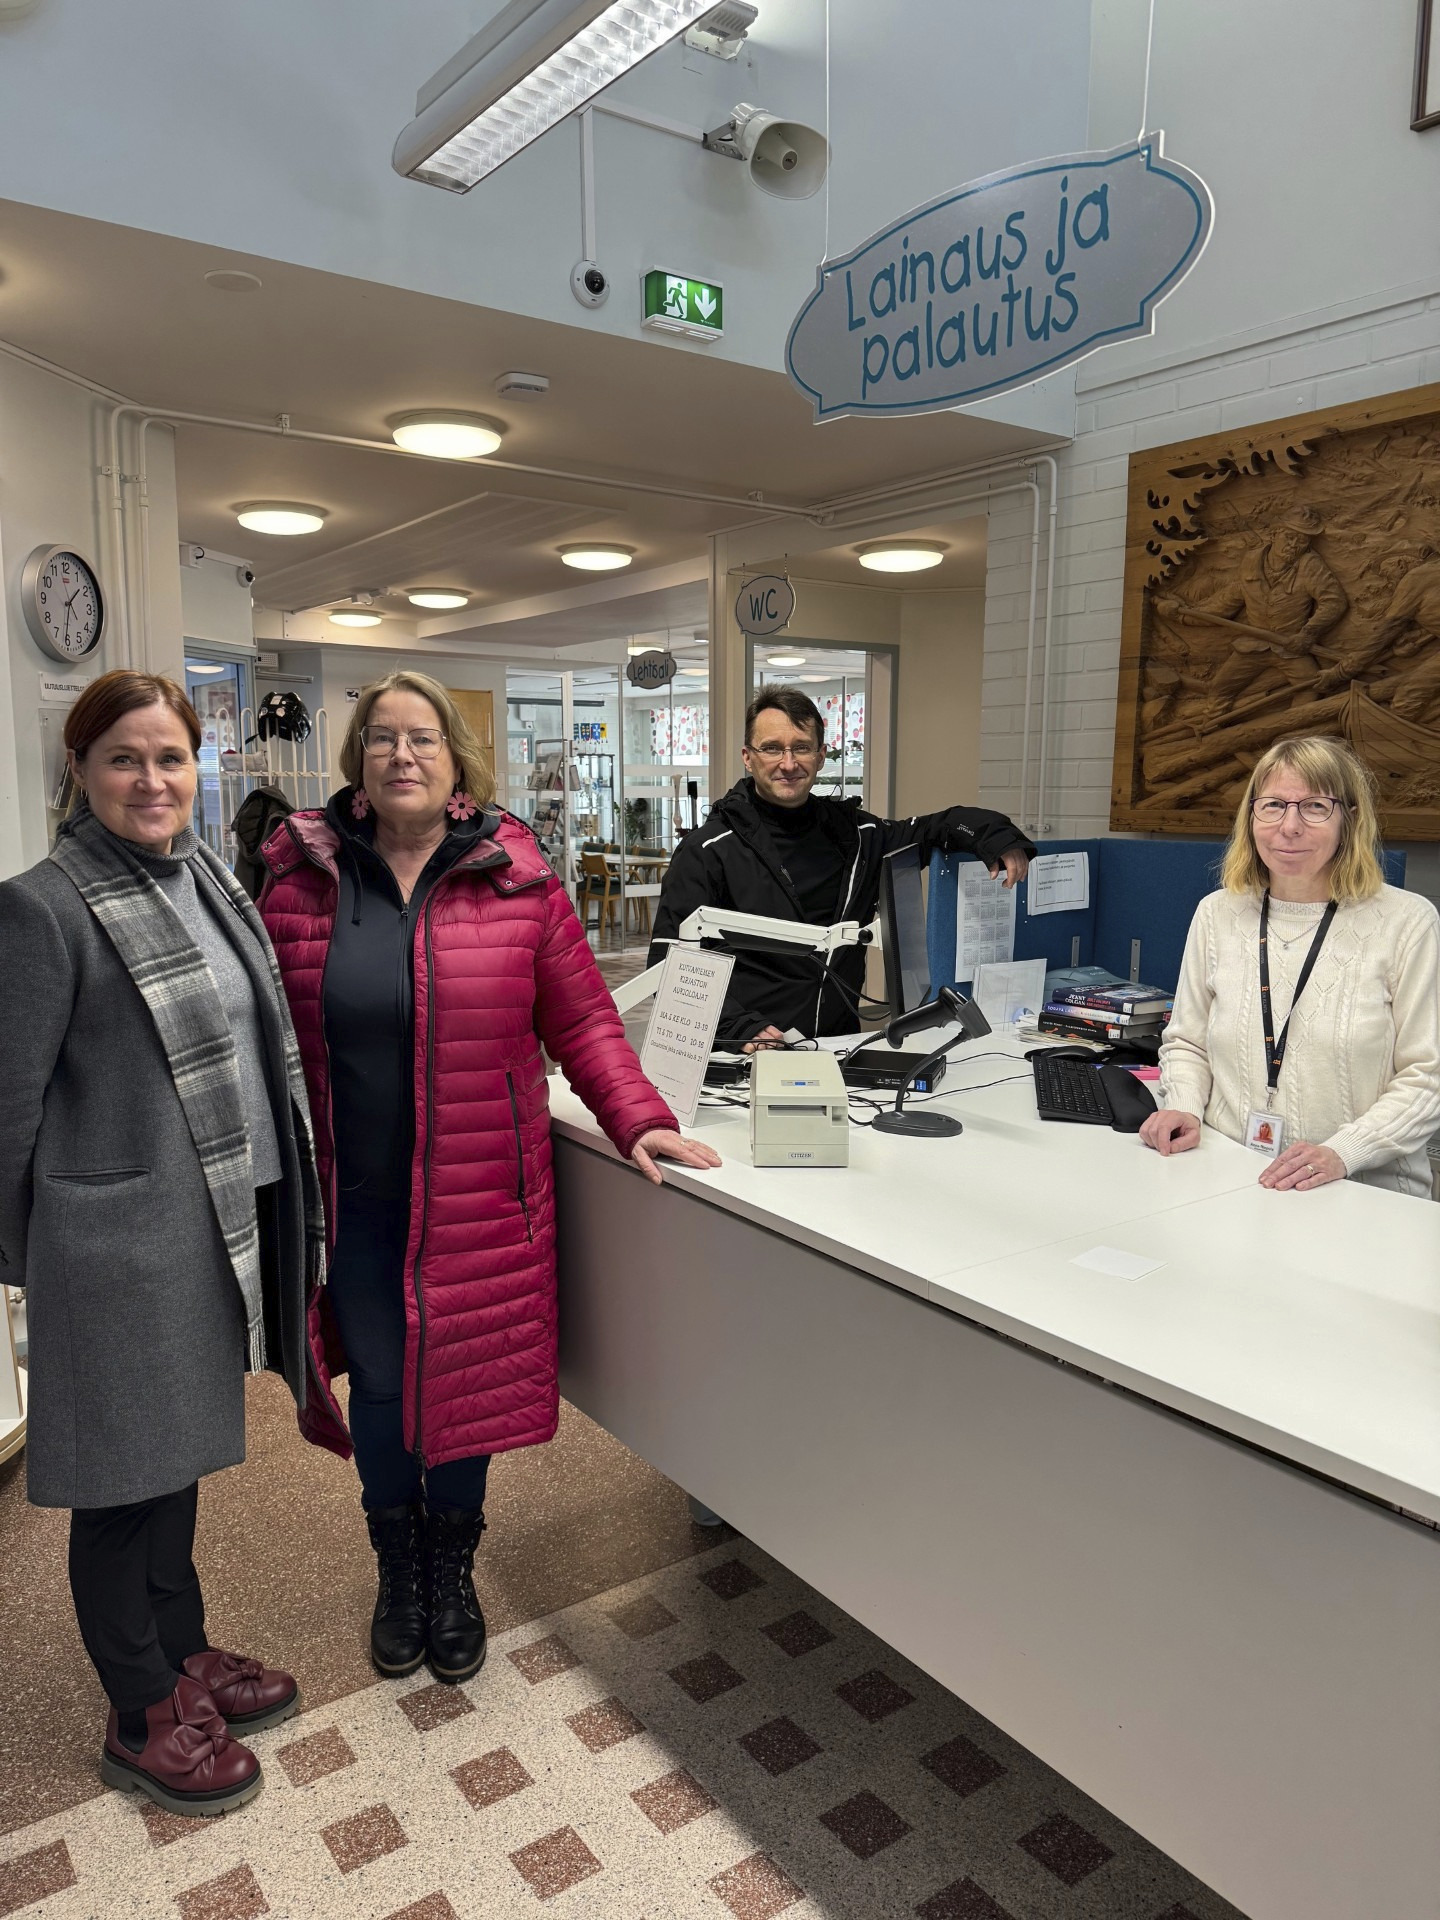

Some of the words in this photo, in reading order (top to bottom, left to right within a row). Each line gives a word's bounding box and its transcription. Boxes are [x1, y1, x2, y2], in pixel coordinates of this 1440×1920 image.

[846, 210, 1028, 331] Lainaus
[1045, 176, 1110, 275] ja
[862, 271, 1079, 400] palautus
[50, 564, 58, 577] 11
[61, 561, 70, 575] 12
[42, 575, 52, 589] 10
[75, 571, 79, 583] 1
[82, 585, 89, 597] 2
[40, 591, 47, 605] 9
[749, 587, 779, 622] WC
[86, 603, 92, 616] 3
[44, 611, 51, 624] 8
[53, 626, 60, 639] 7
[83, 621, 89, 634] 4
[65, 633, 71, 647] 6
[76, 631, 82, 644] 5
[632, 658, 670, 681] Lehtisali
[679, 975, 708, 989] KIRJASTON
[672, 986, 709, 1002] AUKIOLOAJAT
[680, 1017, 691, 1026] KLO
[675, 1033, 687, 1043] KLO
